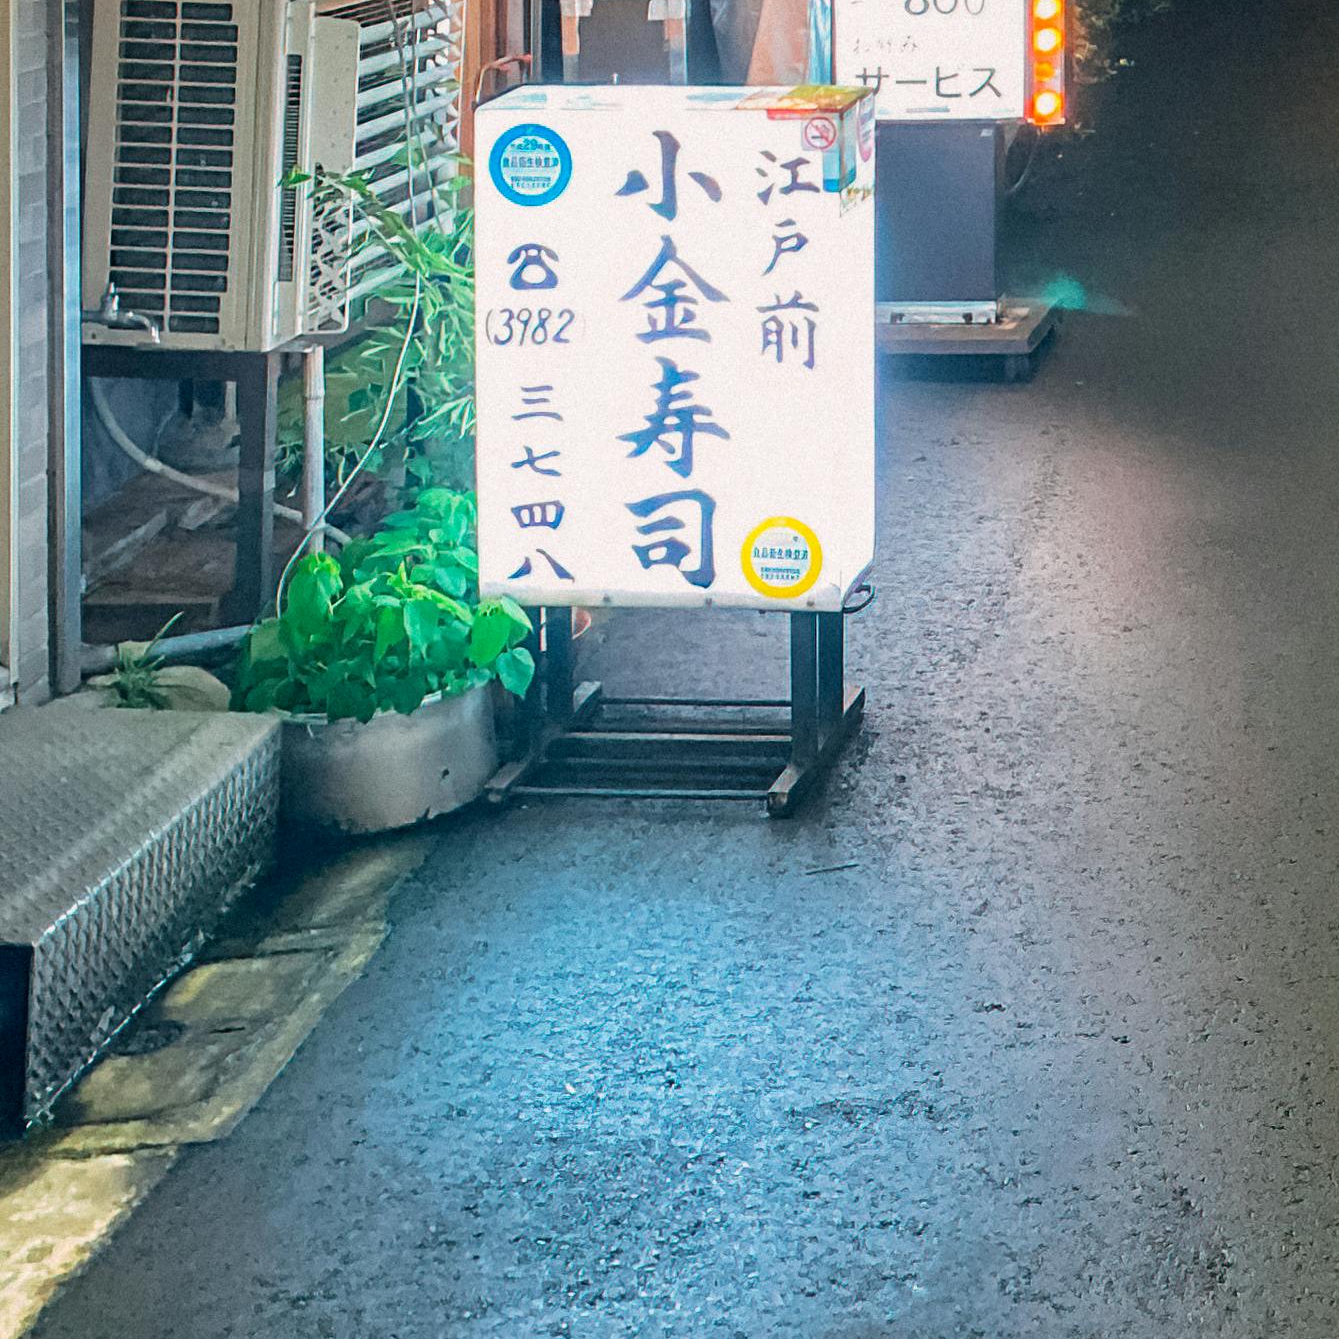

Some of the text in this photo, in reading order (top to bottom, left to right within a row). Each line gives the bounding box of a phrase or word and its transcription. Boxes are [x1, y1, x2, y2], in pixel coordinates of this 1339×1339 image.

[855, 65, 1002, 98] サービス
[614, 130, 731, 589] 小金寿司
[755, 150, 822, 370] 江戸前
[507, 384, 576, 584] 三七四八
